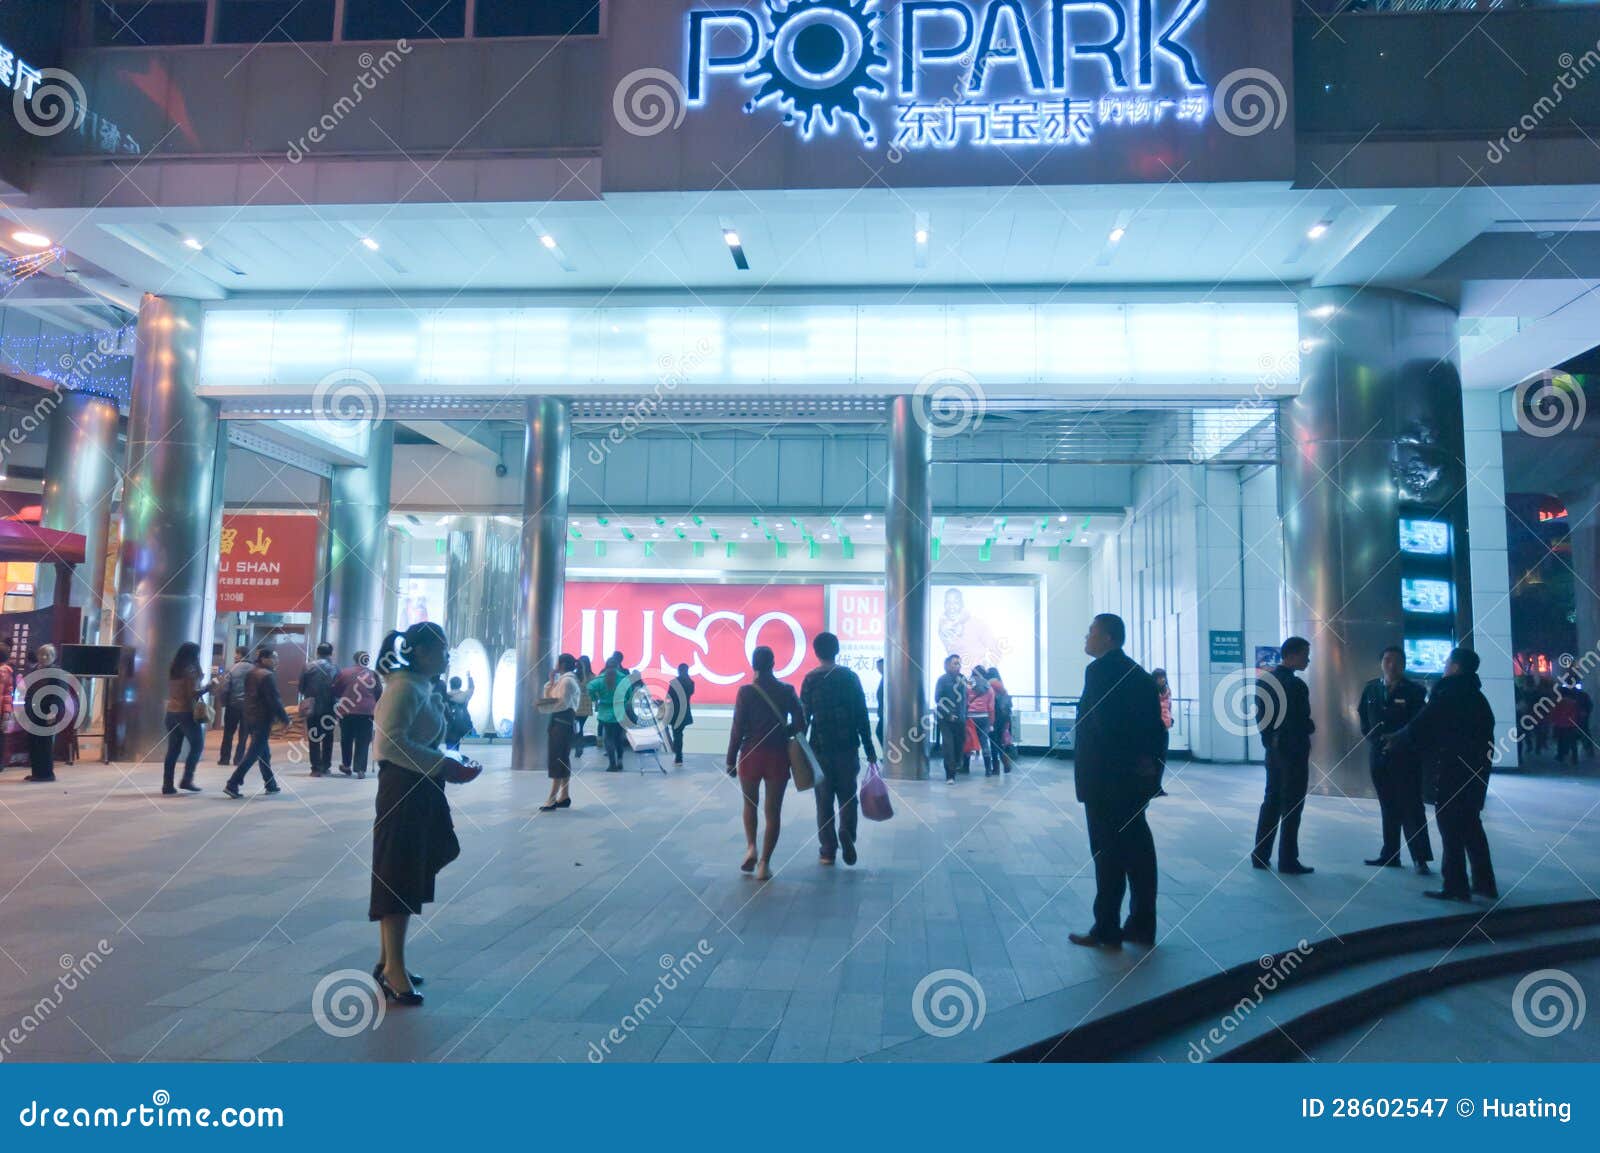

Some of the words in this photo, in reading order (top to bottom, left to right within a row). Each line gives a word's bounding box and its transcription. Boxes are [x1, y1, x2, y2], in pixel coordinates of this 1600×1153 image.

[893, 99, 1093, 147] 东方宝泰
[236, 562, 280, 573] SHAN
[842, 596, 881, 615] UNI
[842, 617, 882, 638] QLO
